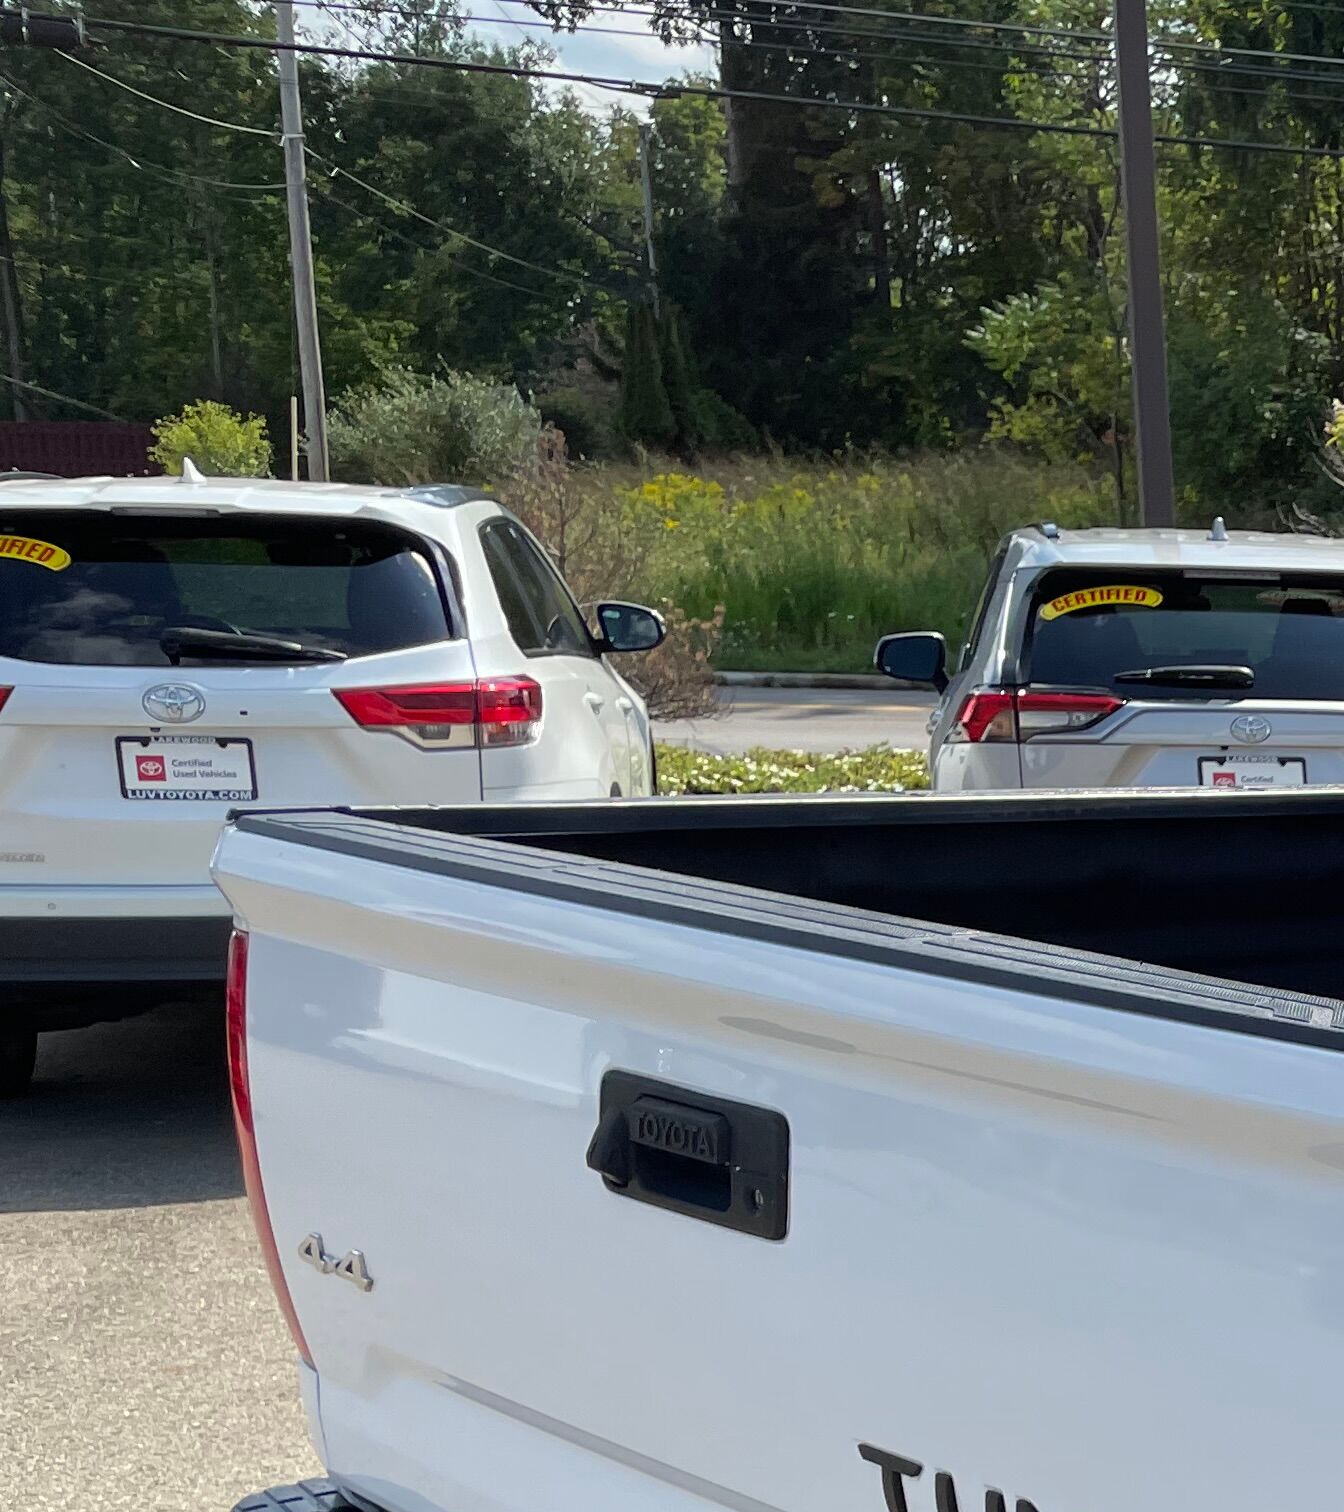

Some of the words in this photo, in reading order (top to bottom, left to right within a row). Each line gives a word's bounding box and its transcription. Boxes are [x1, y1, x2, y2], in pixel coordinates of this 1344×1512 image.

[1051, 588, 1148, 612] CERTIFIED
[171, 759, 212, 768] Certified
[173, 770, 197, 778] Used
[198, 770, 238, 778] Vehicles
[128, 790, 252, 800] LUVTOYOTA.COM
[634, 1111, 717, 1159] TOYOTA
[298, 1232, 374, 1292] 4x4
